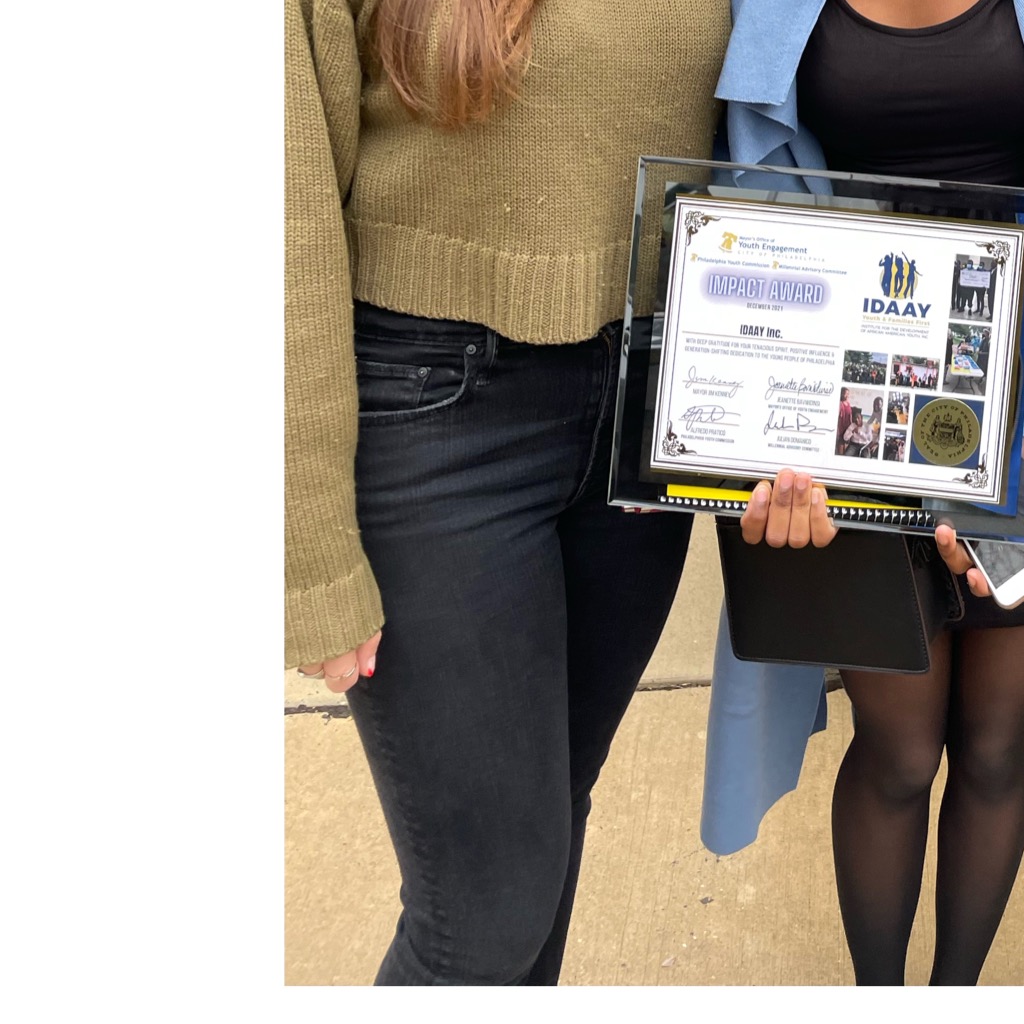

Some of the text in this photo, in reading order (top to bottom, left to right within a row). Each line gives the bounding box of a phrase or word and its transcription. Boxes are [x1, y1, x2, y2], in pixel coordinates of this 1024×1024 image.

[738, 241, 807, 254] Youth Engagement
[697, 256, 726, 264] Philadelphia
[772, 253, 826, 262] PHILADELPHIA
[708, 274, 823, 304] IMPACT AWARD
[863, 298, 932, 318] IDAAY
[740, 324, 783, 339] IDAAY Inc.
[806, 357, 835, 365] PHILADELPHIA
[690, 427, 708, 435] ALFREDO
[921, 413, 930, 427] THE
[932, 405, 948, 413] CITY
[948, 411, 972, 458] PHILADELPHIA
